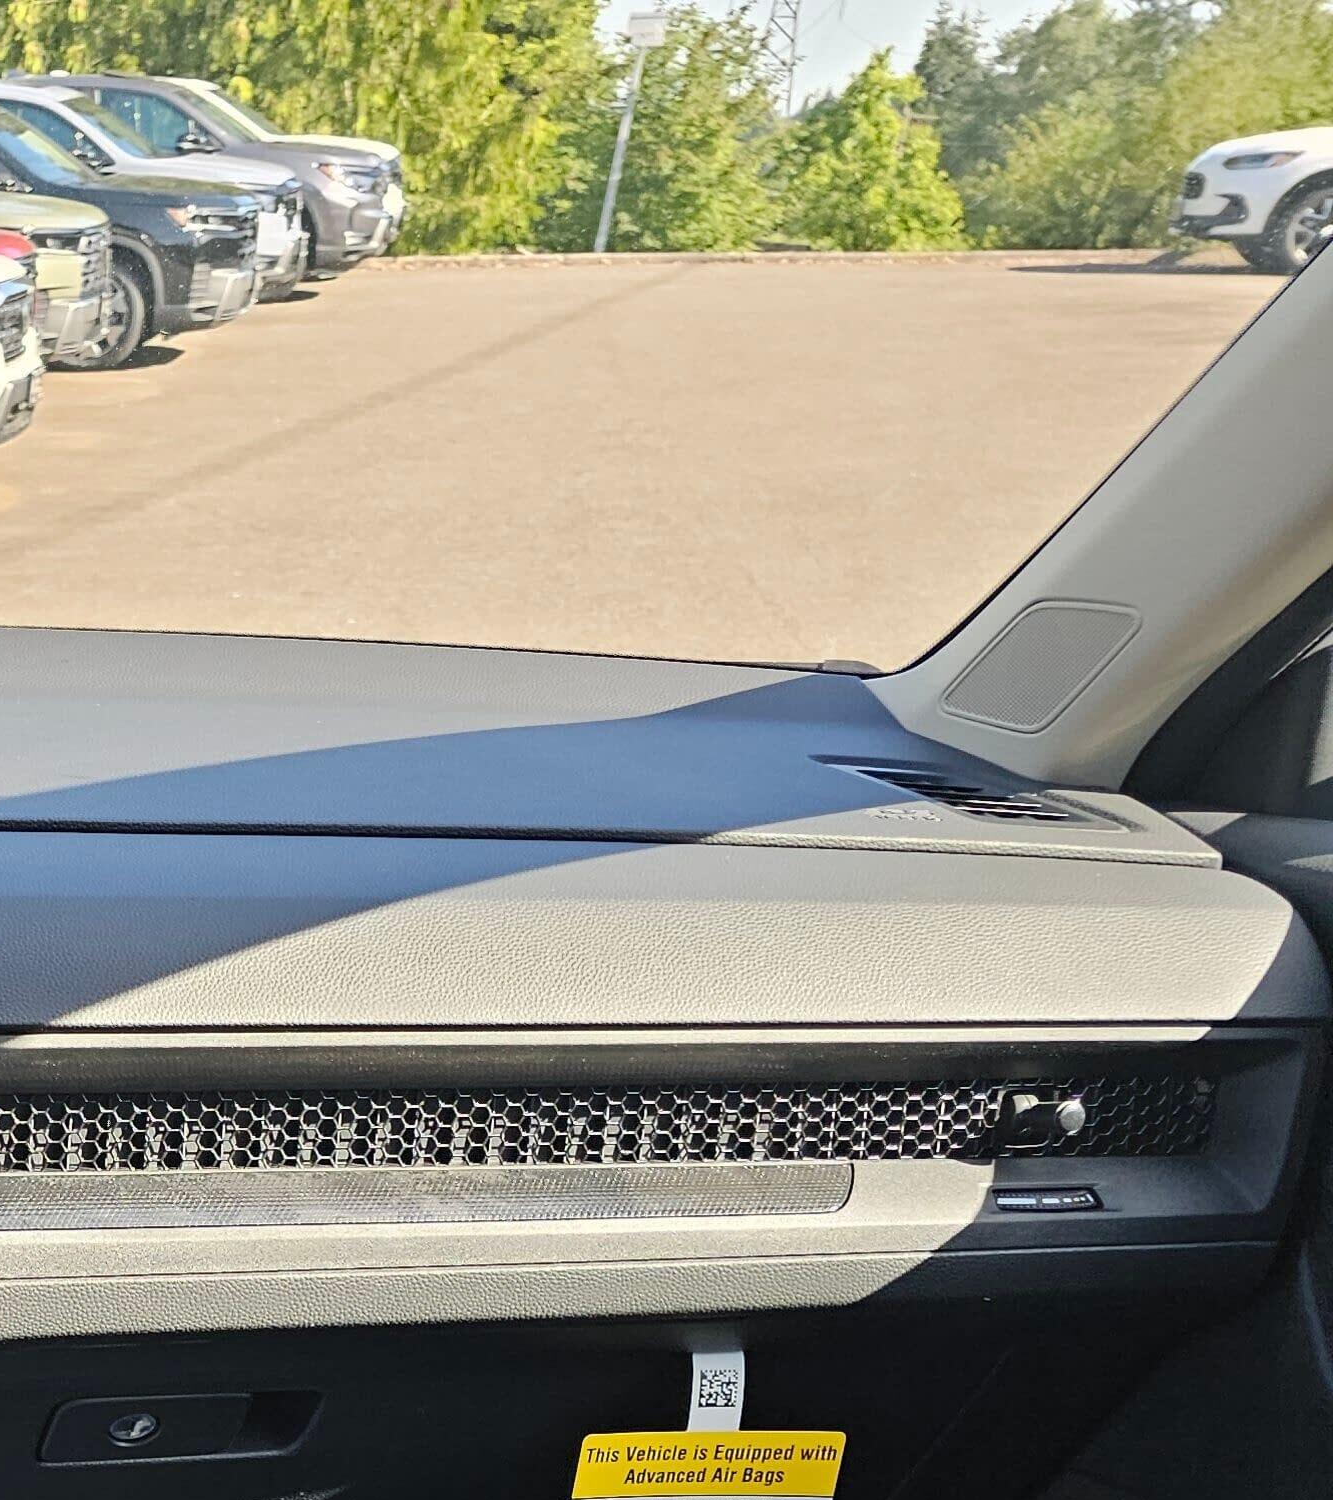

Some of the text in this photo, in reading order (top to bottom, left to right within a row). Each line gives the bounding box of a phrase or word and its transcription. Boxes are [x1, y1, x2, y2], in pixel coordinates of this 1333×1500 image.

[586, 1444, 837, 1463] This Vehicle is Equipped with
[623, 1467, 785, 1486] Advanced Air Bags
